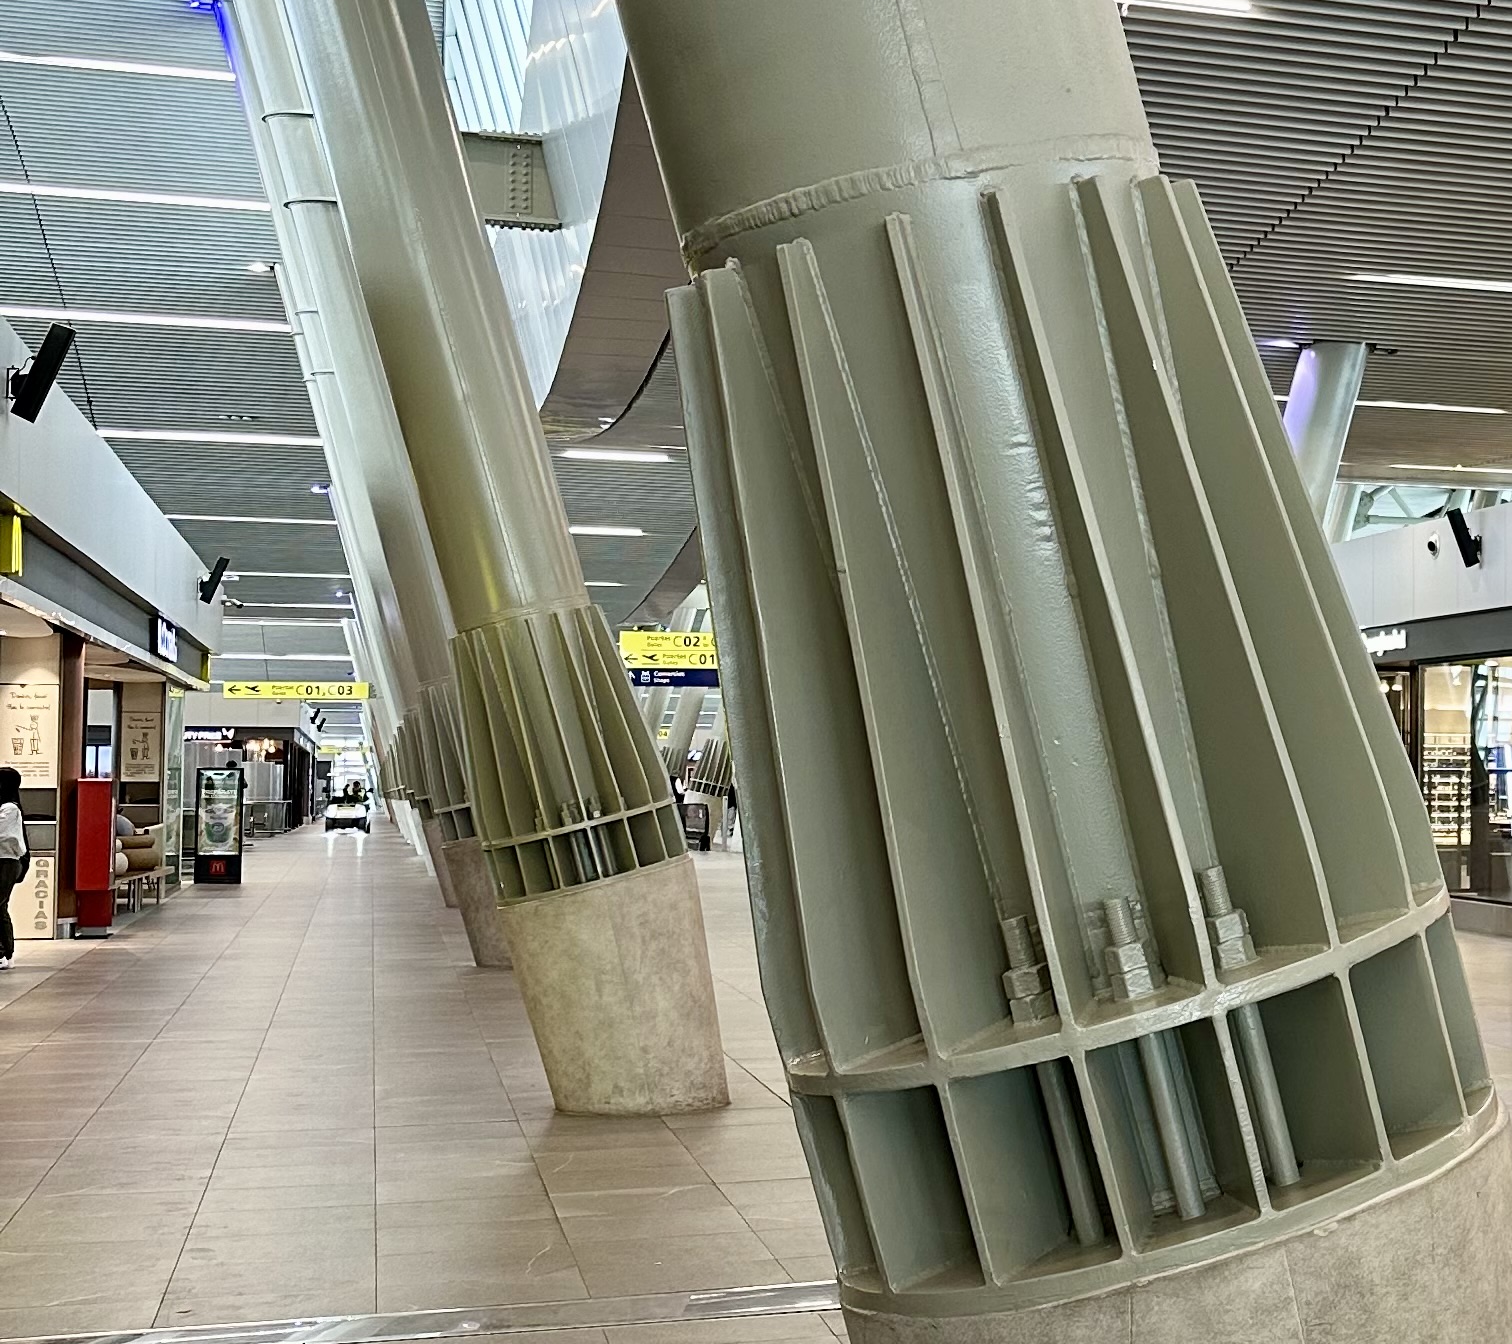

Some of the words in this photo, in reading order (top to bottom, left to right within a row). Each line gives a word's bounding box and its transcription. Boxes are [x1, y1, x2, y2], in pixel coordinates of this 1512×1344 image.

[673, 636, 700, 647] C02
[328, 685, 353, 695] C03
[34, 859, 50, 930] GRACIAS
